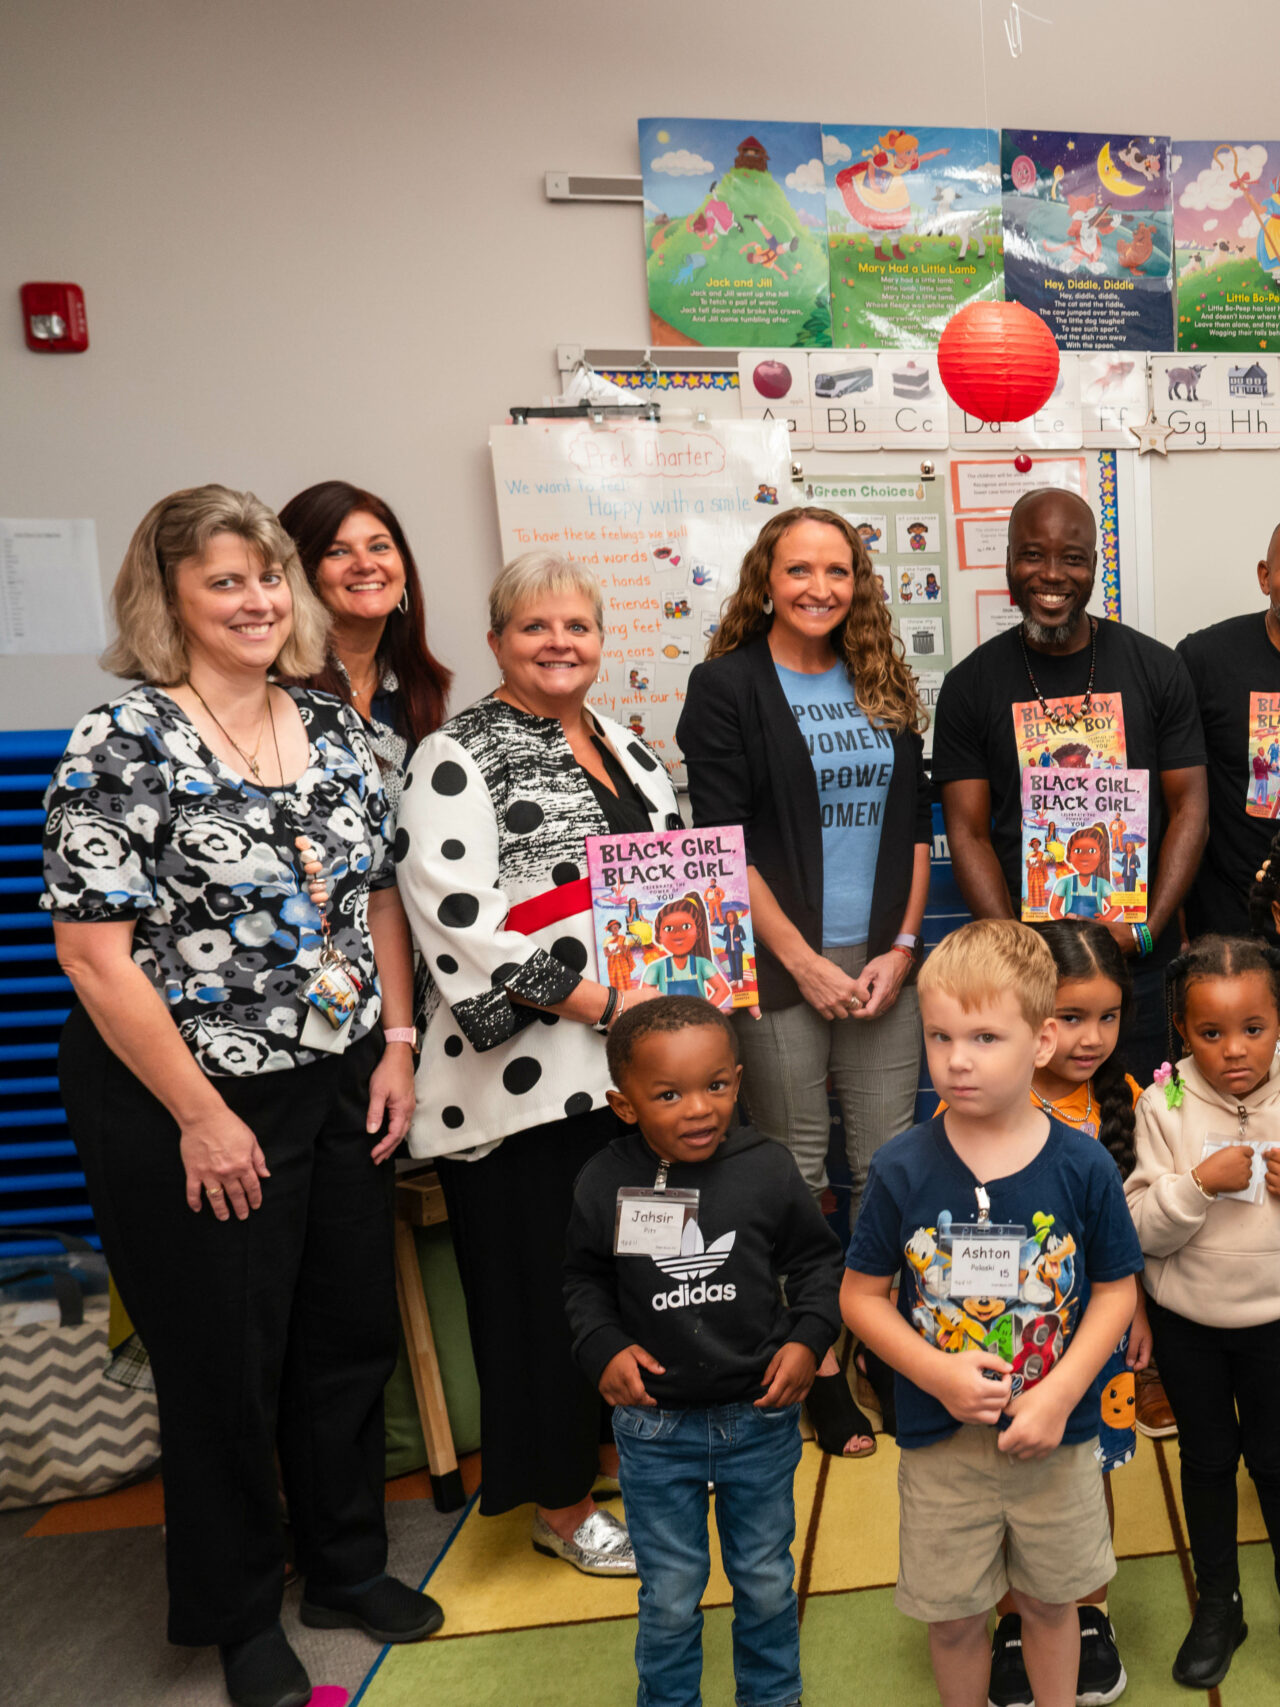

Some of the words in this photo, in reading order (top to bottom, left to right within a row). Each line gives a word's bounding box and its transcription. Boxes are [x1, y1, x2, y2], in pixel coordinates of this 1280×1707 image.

[858, 262, 886, 275] Mary
[888, 263, 909, 273] Had
[911, 265, 919, 274] a
[921, 263, 946, 274] Little
[949, 264, 977, 275] Lamb
[705, 277, 731, 288] Jack
[733, 277, 754, 288] and
[756, 277, 773, 288] Jill
[1044, 279, 1065, 291] Hey,
[1067, 279, 1101, 291] Diddle,
[1103, 279, 1135, 290] Diddle
[1226, 292, 1250, 303] Little
[1039, 308, 1051, 316] The
[1066, 309, 1091, 317] jumped
[1084, 317, 1097, 325] dog
[1098, 317, 1125, 325] laughed
[827, 408, 866, 433] Bb
[895, 407, 933, 433] Cc
[1168, 409, 1207, 445] Gg
[1231, 409, 1268, 433] Hh
[643, 441, 714, 468] Charter
[505, 480, 530, 496] We
[535, 480, 572, 495] want
[814, 485, 856, 498] Green
[860, 485, 915, 498] Choices
[588, 495, 644, 524] Happy
[650, 488, 690, 515] with
[693, 501, 705, 515] a
[710, 487, 752, 513] smile
[512, 528, 531, 544] To
[532, 527, 560, 544] have
[564, 527, 597, 543] these
[600, 526, 646, 545] feelings
[648, 529, 664, 541] we
[666, 525, 688, 539] will
[603, 550, 648, 565] words
[612, 574, 652, 588] hands
[608, 597, 660, 613] friends
[633, 622, 663, 635] feet
[626, 646, 656, 659] ears
[586, 691, 617, 713] icely
[620, 691, 648, 705] with
[650, 694, 671, 704] our
[791, 703, 862, 723] POWE
[1021, 703, 1075, 723] BLCK
[1083, 715, 1115, 734] BOY
[821, 763, 893, 792] POWE
[1030, 775, 1089, 792] BLACK
[1095, 777, 1140, 794] GIRL,
[1030, 794, 1088, 811] BLACK
[1095, 796, 1136, 812] GIRL
[821, 802, 882, 829] OMEN
[599, 841, 674, 864] BLACK
[681, 836, 737, 857] GIRL,
[601, 864, 677, 887] BLACK
[683, 859, 734, 880] GIRL
[631, 1210, 674, 1224] Jahsir
[961, 1245, 1011, 1260] Ashton
[652, 1281, 737, 1311] adidas
